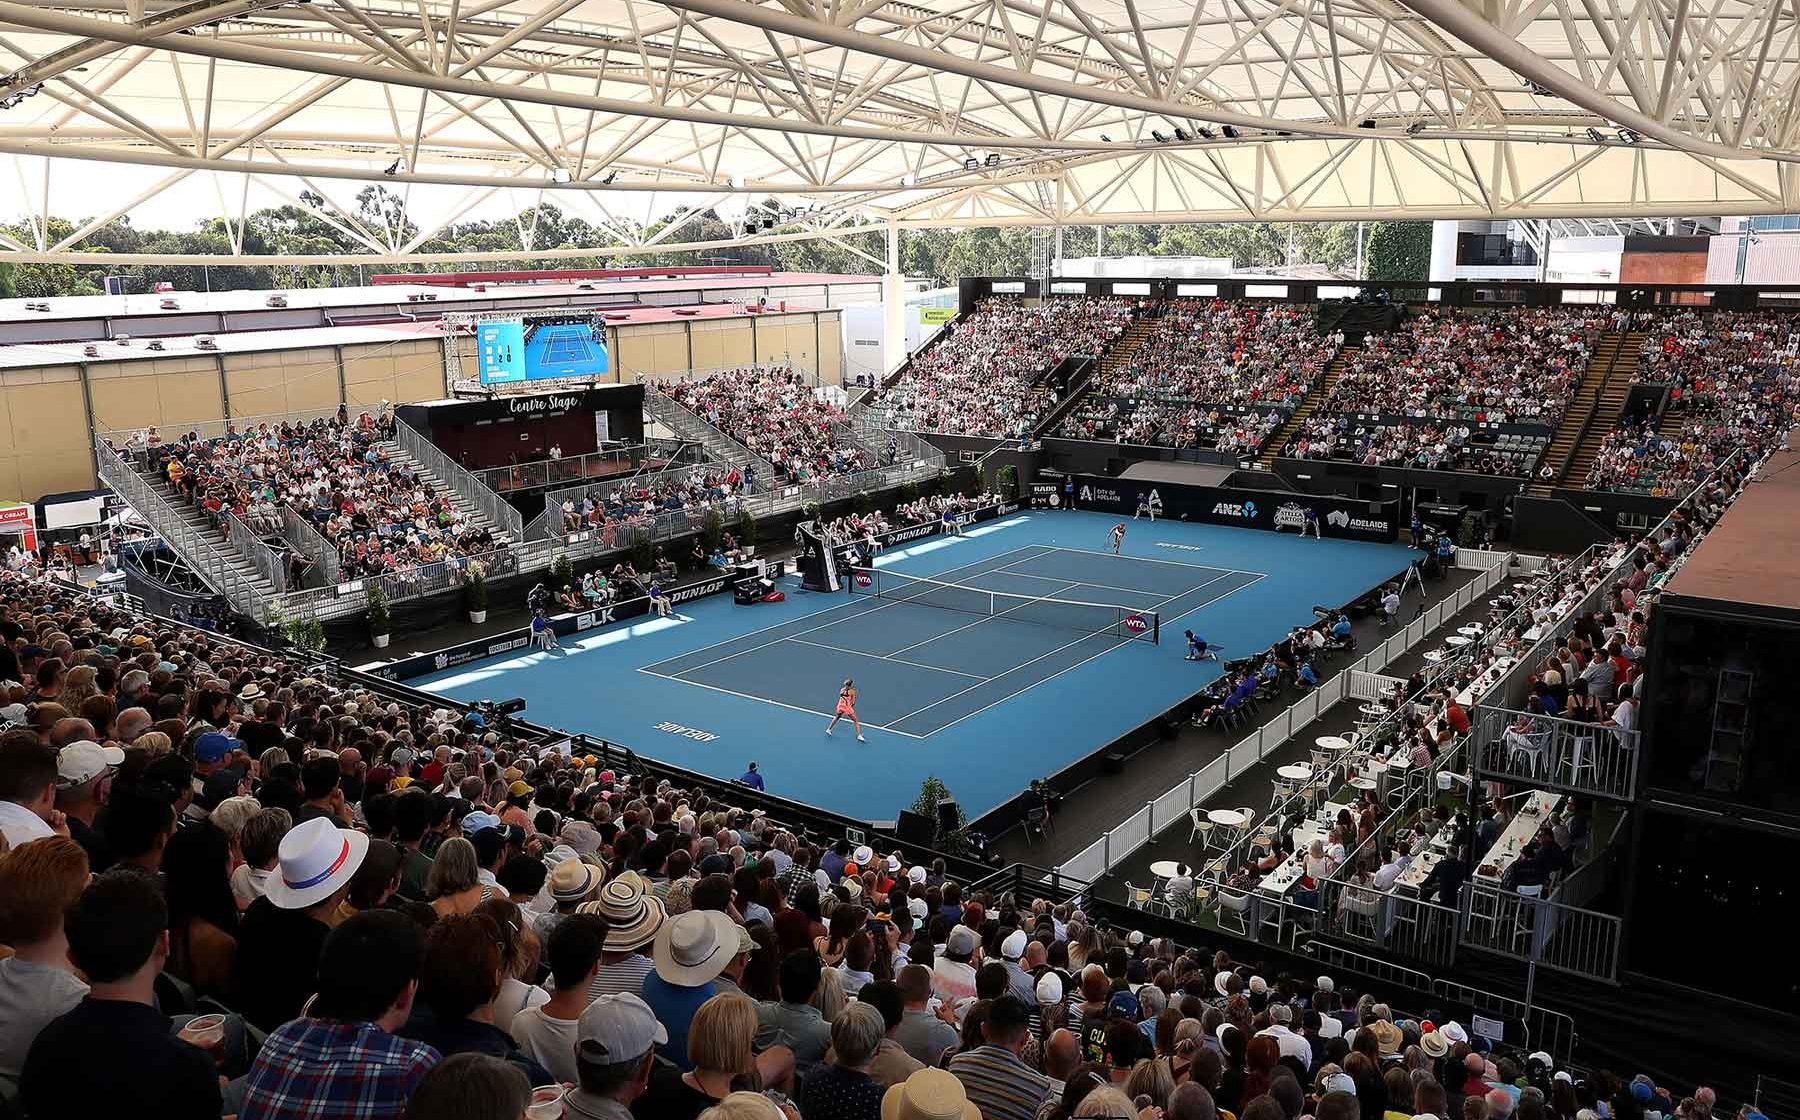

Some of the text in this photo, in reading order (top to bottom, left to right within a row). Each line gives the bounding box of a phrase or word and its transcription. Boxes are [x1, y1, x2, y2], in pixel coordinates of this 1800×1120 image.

[498, 354, 503, 364] 2
[510, 395, 578, 413] Centre Stage
[1212, 502, 1242, 516] ANZ
[1350, 518, 1388, 529] ADELAIDE
[895, 526, 933, 542] DUNLOP
[855, 575, 871, 585] WTA
[671, 580, 725, 603] DUNLOP
[577, 607, 616, 631] BLK
[1126, 619, 1146, 629] WTA
